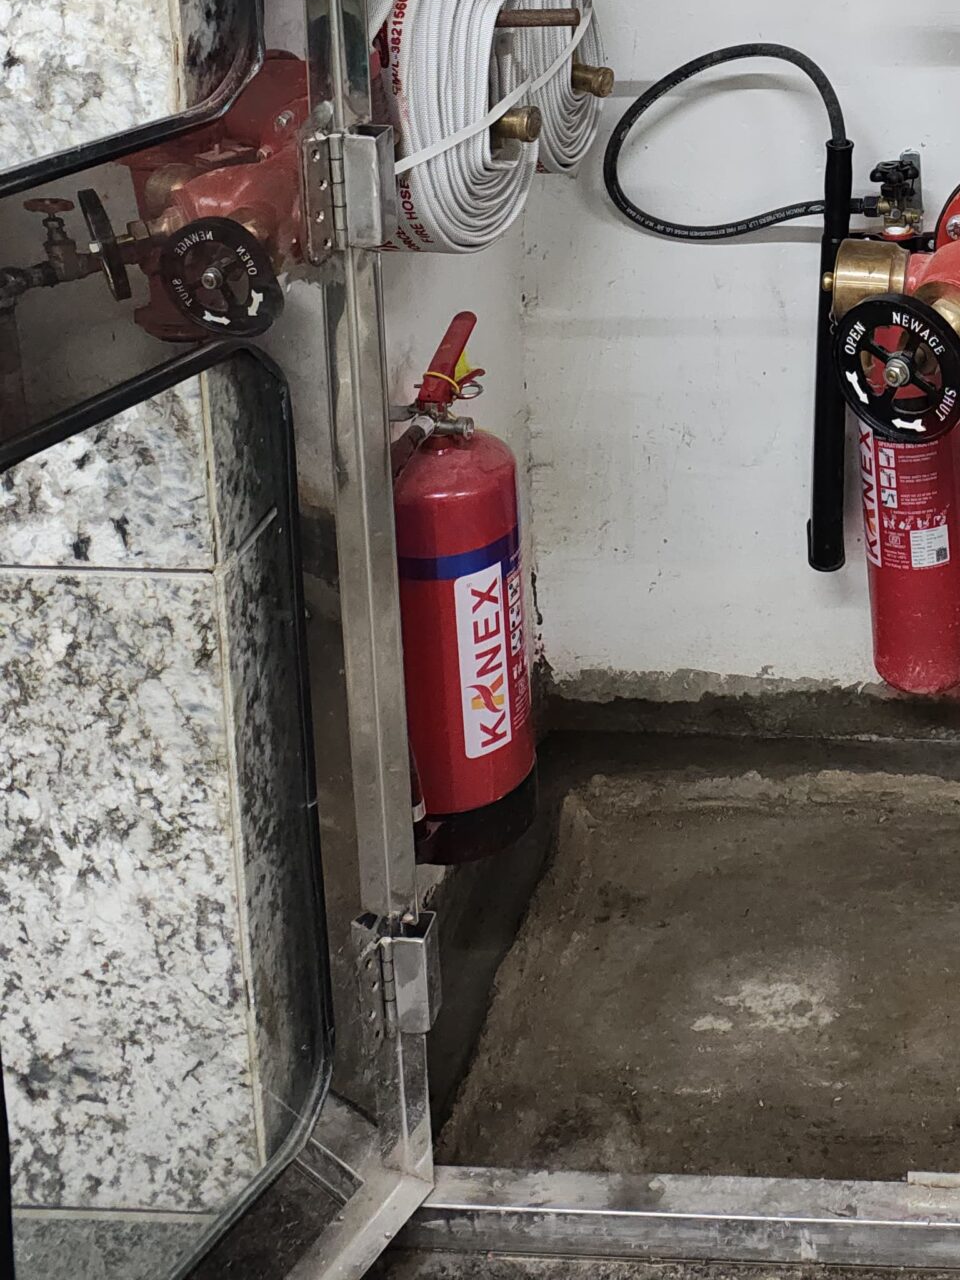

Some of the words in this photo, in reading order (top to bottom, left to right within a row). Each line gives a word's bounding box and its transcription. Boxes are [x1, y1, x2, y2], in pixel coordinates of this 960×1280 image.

[399, 178, 418, 220] HOSE
[410, 223, 434, 244] FIRE
[674, 228, 689, 236] HOSE
[690, 228, 726, 237] EXTINGUISHER
[844, 321, 866, 355] OPEN
[892, 311, 946, 356] NEWAGE
[935, 387, 957, 421] SHUT
[860, 431, 879, 561] KANEX
[466, 577, 508, 749] KANEX
